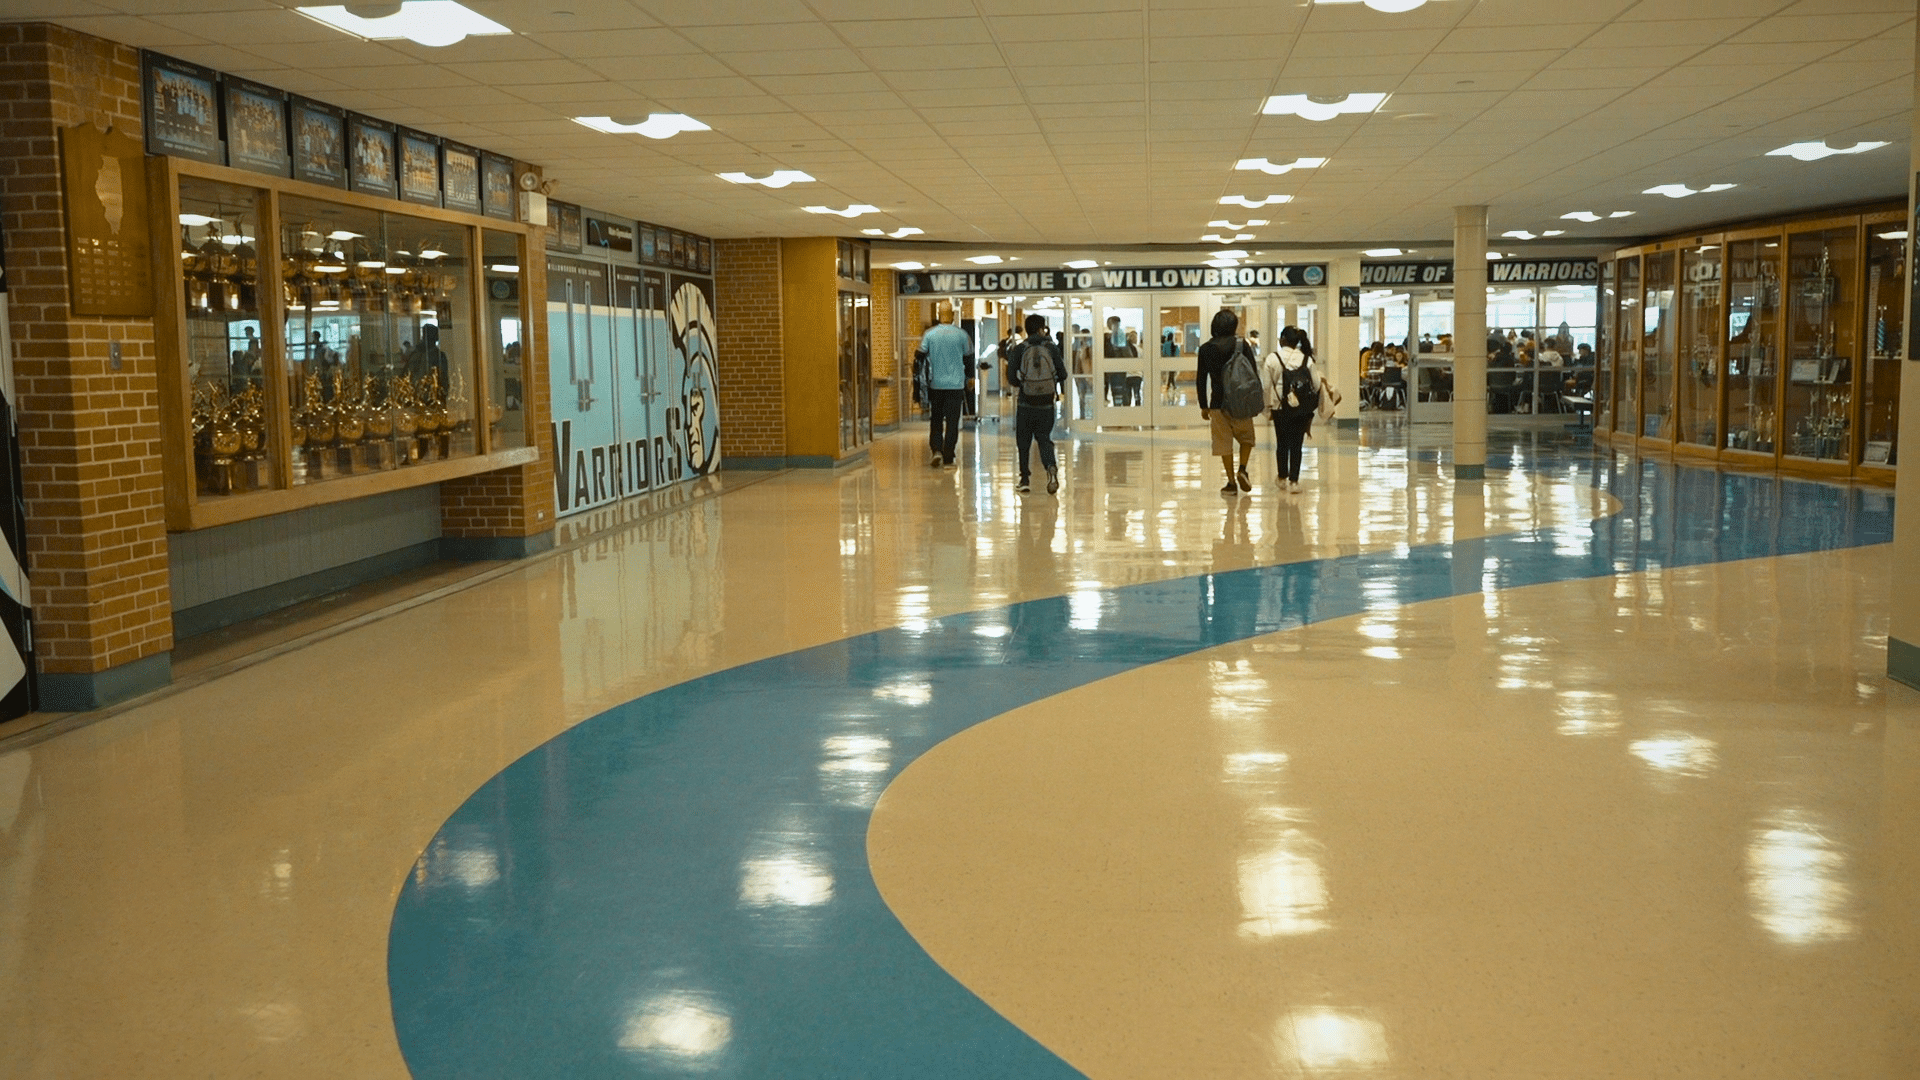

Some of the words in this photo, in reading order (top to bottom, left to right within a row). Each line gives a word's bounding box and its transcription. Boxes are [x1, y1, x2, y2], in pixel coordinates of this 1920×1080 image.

[930, 272, 1054, 291] WELCOME
[1063, 272, 1093, 289] TO
[1102, 267, 1291, 288] WILLOWBROOK
[1361, 265, 1416, 283] HOME
[1422, 265, 1447, 283] OF
[1493, 261, 1598, 282] WARRIORS
